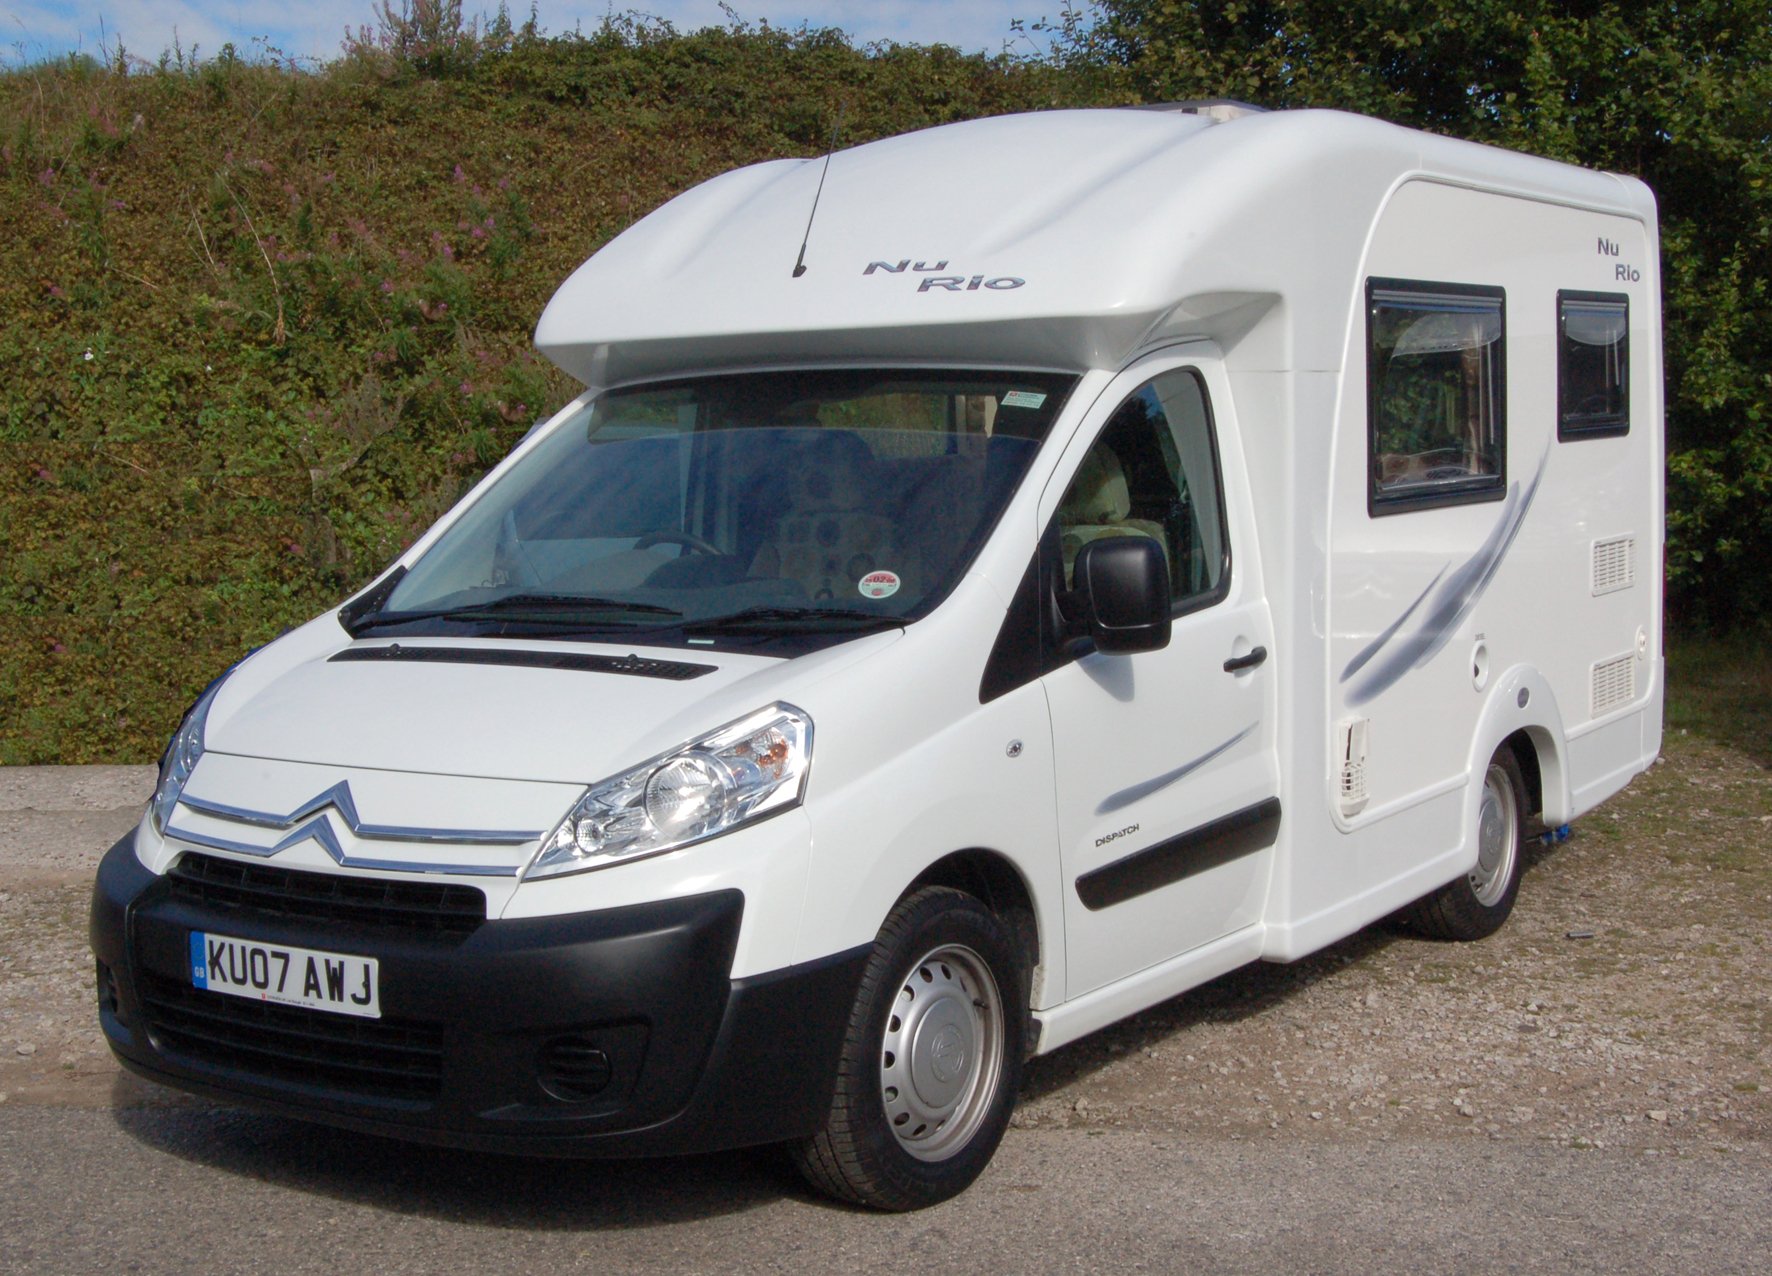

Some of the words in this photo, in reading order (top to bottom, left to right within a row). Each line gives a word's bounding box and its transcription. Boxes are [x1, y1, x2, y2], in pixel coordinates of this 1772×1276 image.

[1597, 237, 1619, 256] Nu
[1615, 263, 1640, 282] Rio
[1095, 823, 1140, 847] DISPATCH
[208, 940, 290, 992] KU07
[303, 956, 372, 1005] AWJ
